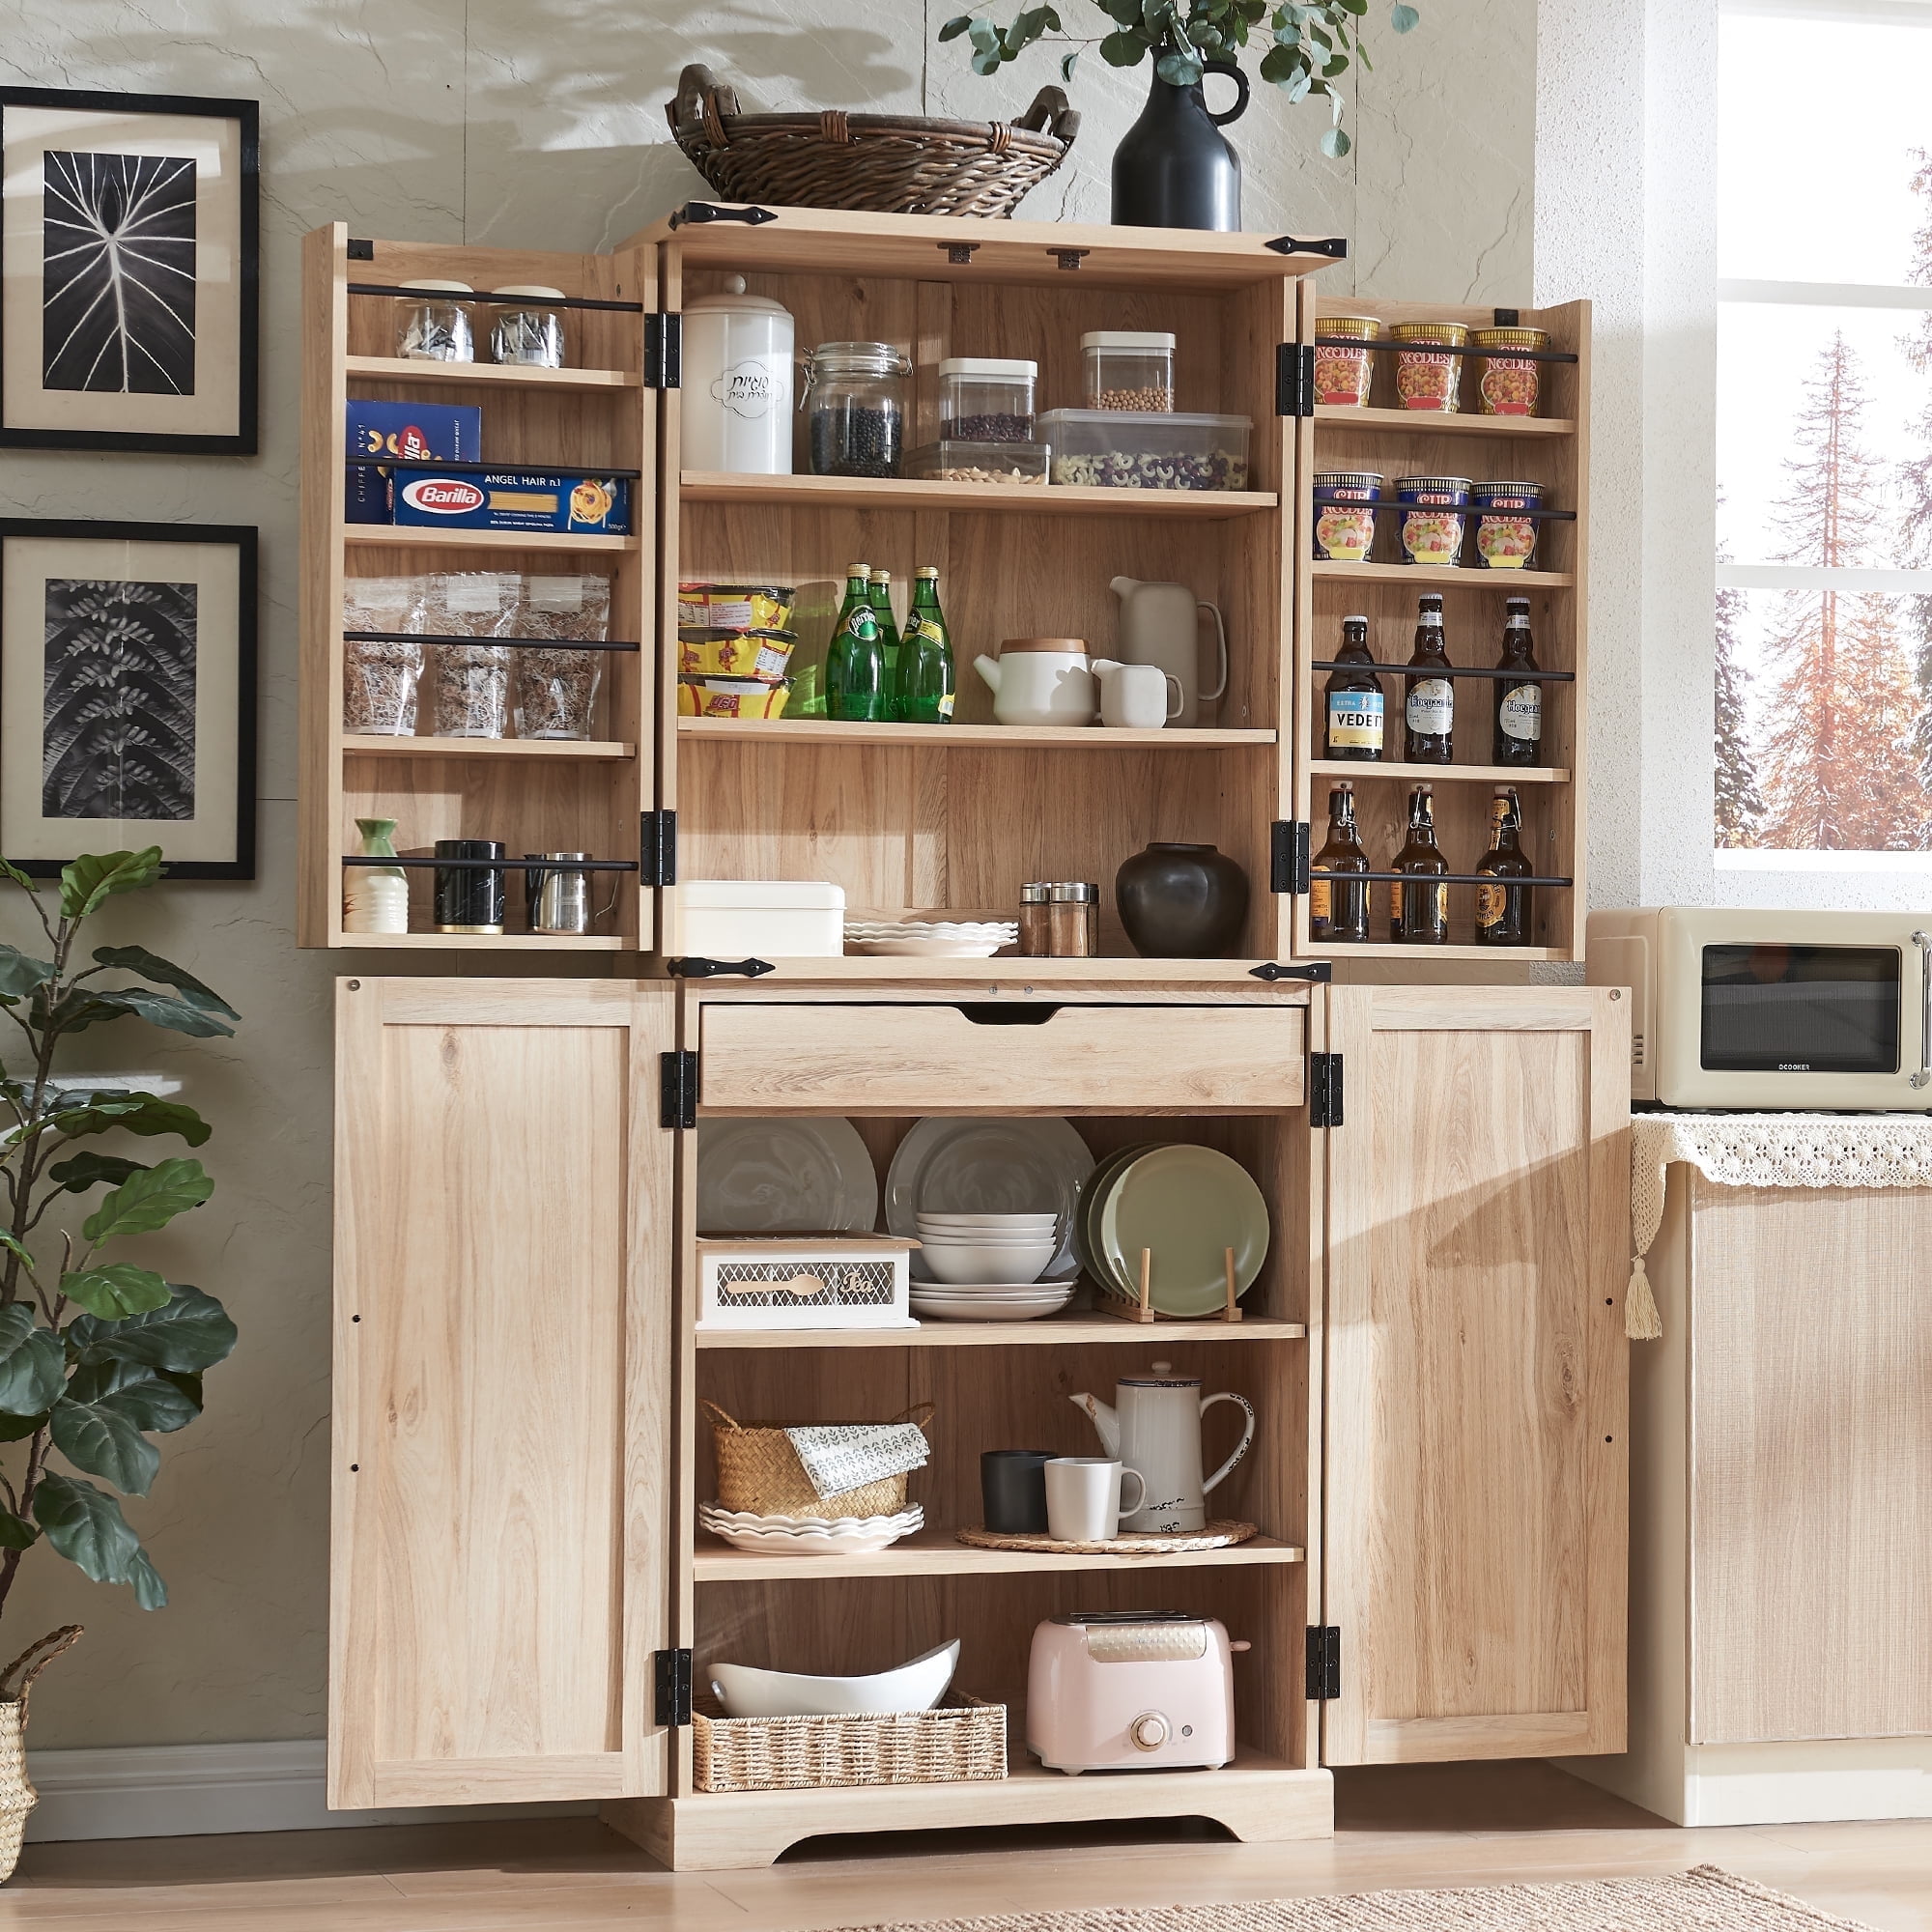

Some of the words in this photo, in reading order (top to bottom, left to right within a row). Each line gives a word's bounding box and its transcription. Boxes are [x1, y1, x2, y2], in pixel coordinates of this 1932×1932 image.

[1399, 352, 1451, 365] NOODLES
[1487, 357, 1537, 371] NOODLES
[357, 454, 366, 502] CHIFFEI
[484, 474, 518, 485] ANGEL
[522, 476, 547, 486] HAIR
[421, 486, 477, 504] Barilla
[839, 1271, 875, 1293] Tea
